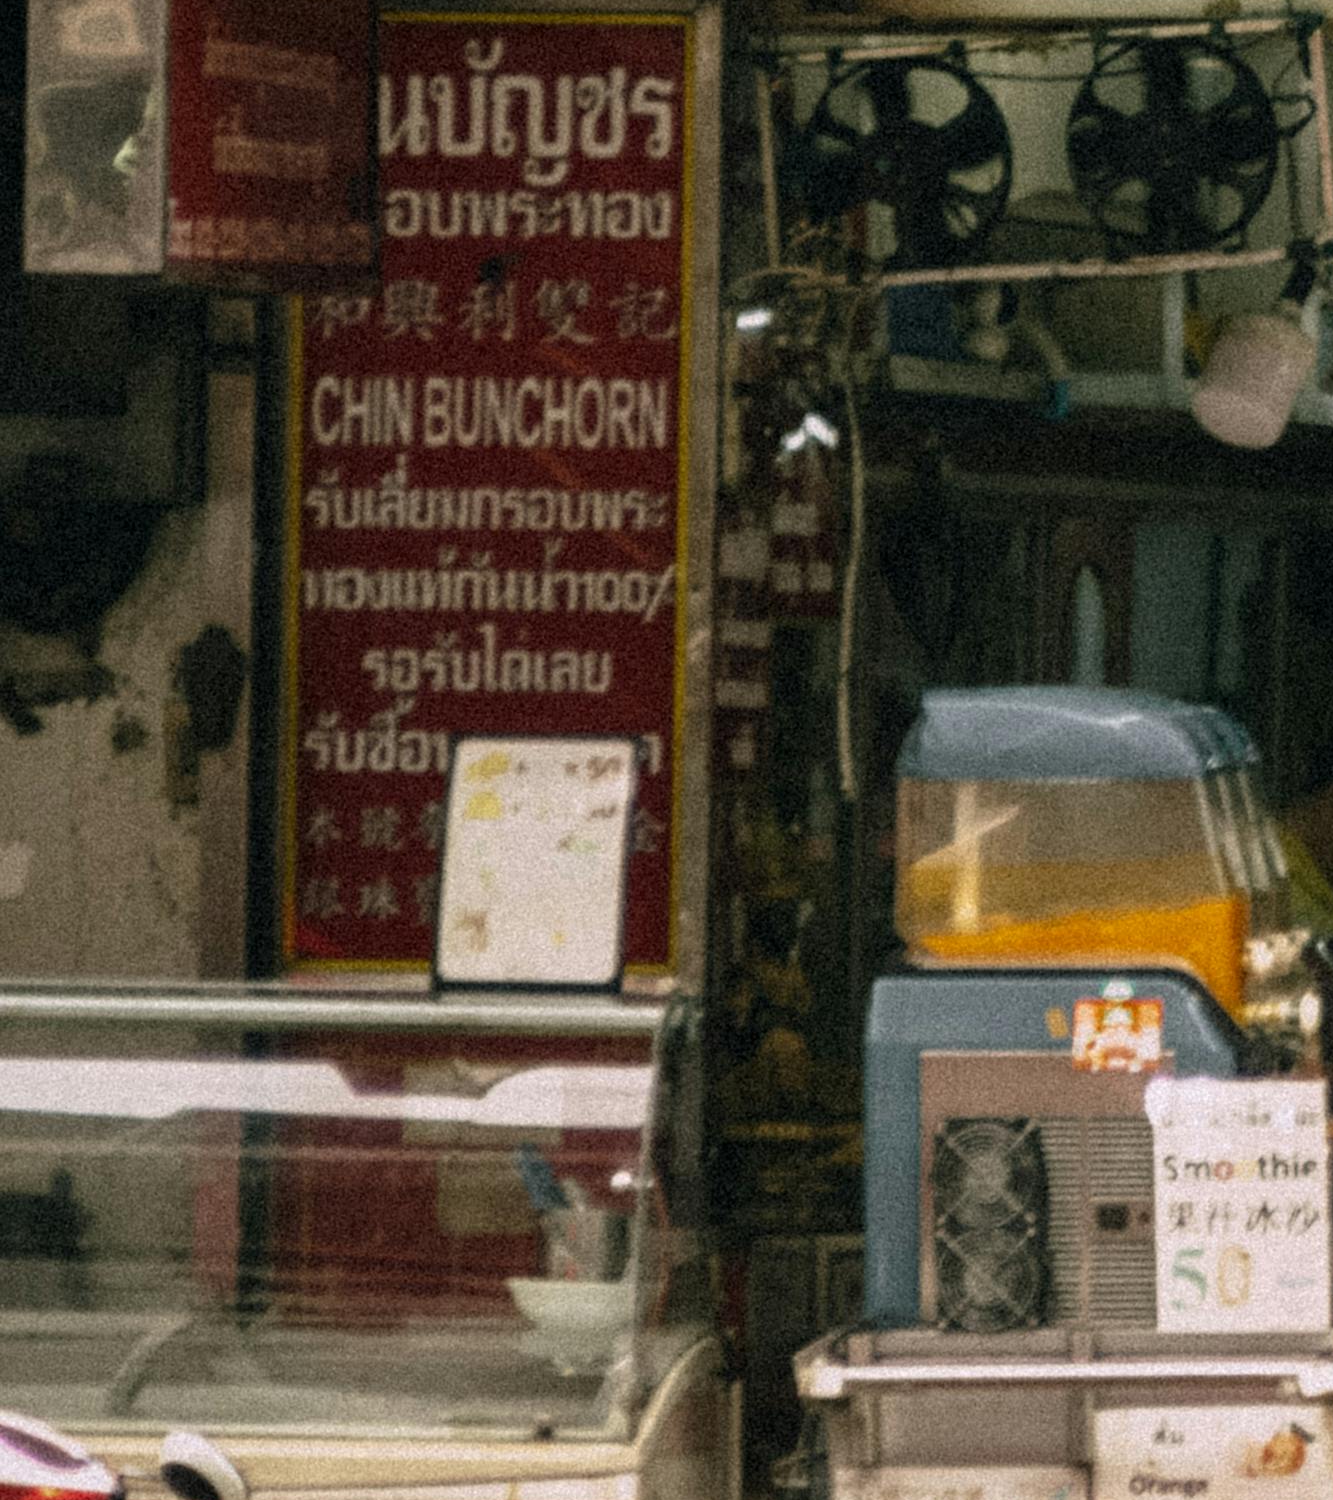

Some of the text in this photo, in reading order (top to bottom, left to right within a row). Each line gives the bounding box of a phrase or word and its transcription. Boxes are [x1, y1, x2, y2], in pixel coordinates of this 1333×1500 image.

[312, 377, 667, 450] CHIN BUNCHORN
[1130, 1474, 1208, 1498] Orange
